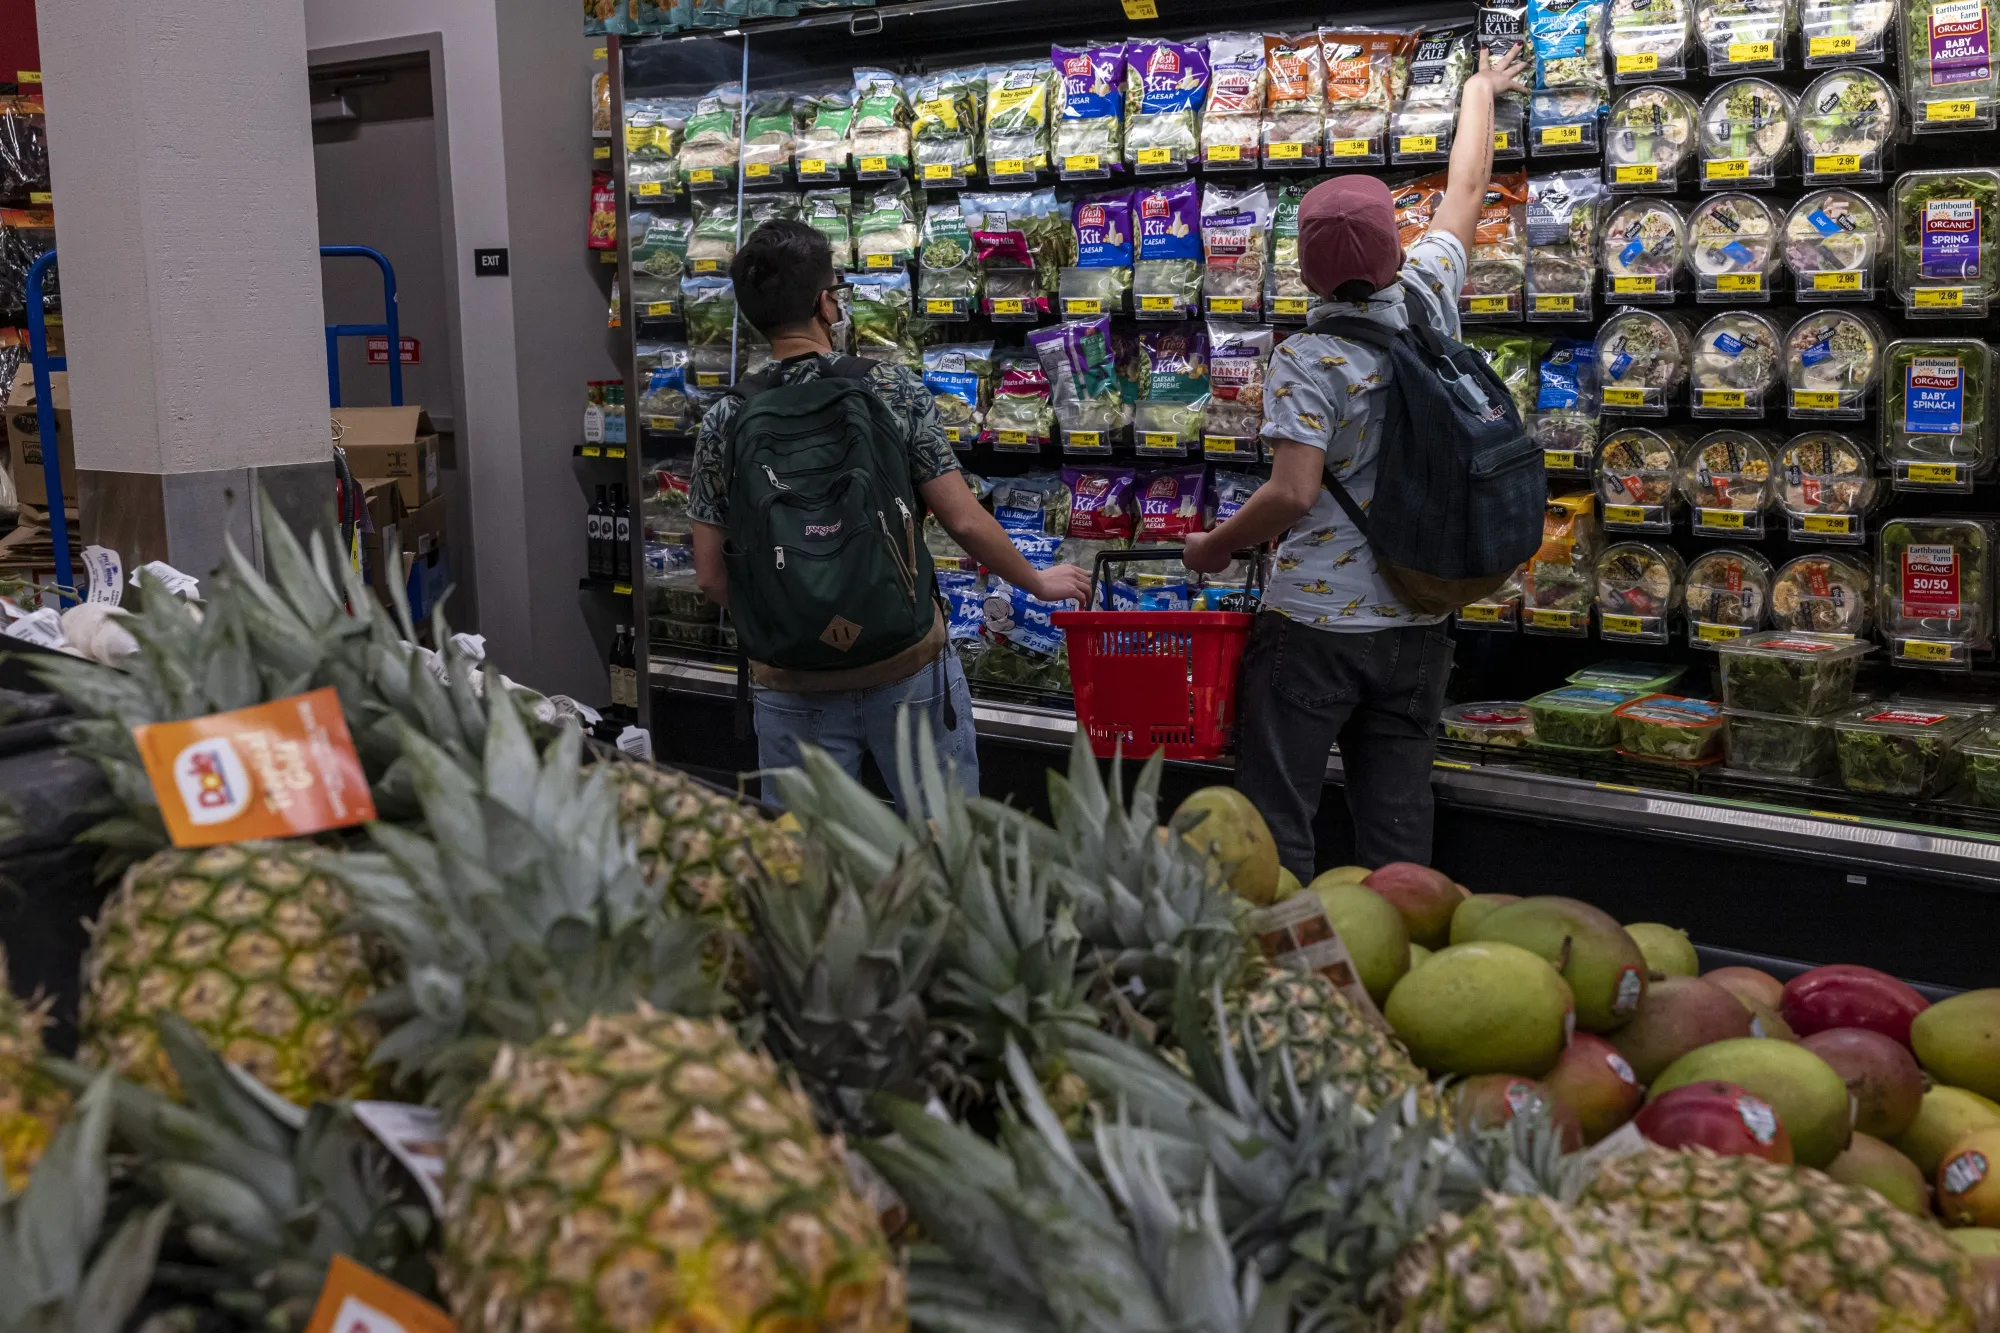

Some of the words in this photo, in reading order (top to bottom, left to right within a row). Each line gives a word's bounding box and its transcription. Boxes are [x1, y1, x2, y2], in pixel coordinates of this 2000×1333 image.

[1936, 2, 1979, 15] Earthbound
[1960, 12, 1979, 20] Farm
[1485, 23, 1519, 34] KALE
[1937, 23, 1979, 34] ORGANIC
[1420, 42, 1447, 50] ASIAGO
[1833, 40, 1851, 48] $2.99
[1945, 37, 1972, 48] BABY
[1751, 45, 1769, 53] $2.99
[1934, 46, 1985, 60] ARUGULA
[1416, 49, 1444, 61] KALE
[1637, 56, 1653, 64] $2.99
[1068, 79, 1086, 95] Kit
[1148, 76, 1171, 91] Kit
[1821, 96, 1838, 113] Bistro
[1951, 103, 1970, 113] $2.99
[1837, 157, 1855, 166] $2.99
[1727, 163, 1744, 171] $2.99
[1929, 202, 1972, 211] Earthbound
[1081, 206, 1101, 218] Fresh
[1953, 209, 1972, 218] Farm
[1145, 220, 1163, 235] Kit
[1839, 216, 1854, 231] Bistro
[1930, 220, 1972, 229] ORGANIC
[1080, 229, 1100, 244] Kit
[1931, 235, 1969, 245] SPRING
[980, 237, 999, 246] Spring
[1000, 237, 1014, 245] Mix
[1144, 238, 1165, 246] CAESAR
[1211, 237, 1246, 246] RANCH
[1080, 246, 1103, 254] CAESAR
[1940, 244, 1959, 254] MIX
[482, 255, 500, 266] EXIT
[1635, 277, 1651, 285] $2.99
[1738, 277, 1756, 285] $2.99
[1836, 274, 1855, 284] $2.99
[1938, 292, 1958, 300] $2.99
[1818, 330, 1835, 341] Bistro
[1741, 335, 1756, 348] Bistro
[942, 357, 963, 365] Ready
[1914, 359, 1956, 367] Earthbound
[1212, 367, 1248, 376] RANCH
[1938, 367, 1956, 375] Farm
[1914, 377, 1954, 386] ORGANIC
[1623, 392, 1639, 400] $2.99
[1723, 393, 1740, 401] $2.99
[1817, 395, 1834, 403] $2.99
[1921, 392, 1946, 401] BABY
[1913, 400, 1956, 409] SPINACH
[19, 415, 39, 424] Tay
[1932, 467, 1951, 476] $2.99
[1152, 480, 1174, 491] Fresh
[1236, 493, 1249, 503] Bis
[1074, 497, 1095, 511] Kit
[1144, 500, 1168, 514] Kit
[1624, 510, 1640, 518] $2.99
[1722, 514, 1739, 522] $2.99
[1826, 519, 1844, 528] $2.99
[1011, 539, 1053, 552] OPEYE
[1909, 546, 1951, 555] Earthbound
[1933, 554, 1951, 562] Farm
[1911, 563, 1951, 574] ORGANIC
[1913, 579, 1948, 589] 50/50
[1221, 595, 1256, 607] Taylr
[1928, 646, 1946, 655] $2.99
[187, 752, 228, 810] Dole
